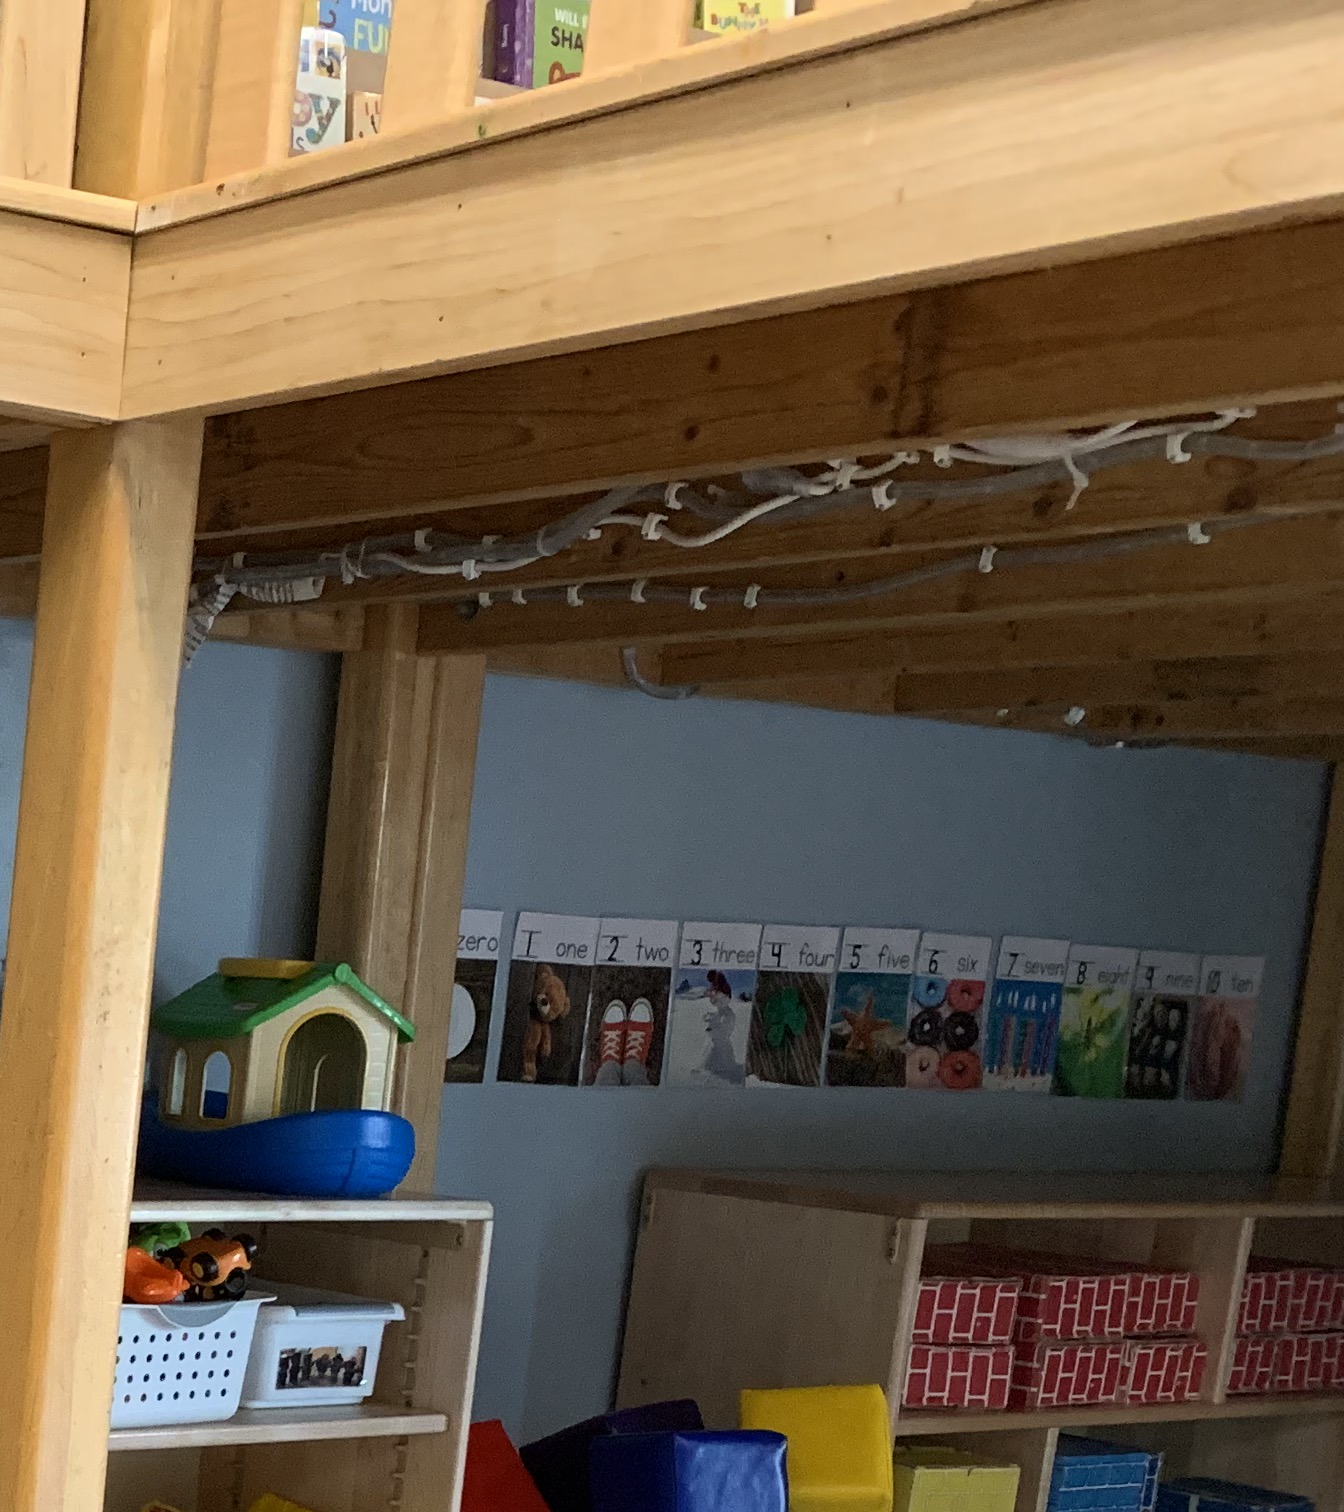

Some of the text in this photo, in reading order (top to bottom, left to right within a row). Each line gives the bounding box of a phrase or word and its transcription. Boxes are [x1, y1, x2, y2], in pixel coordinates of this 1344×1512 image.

[554, 7, 580, 28] WILL
[457, 934, 499, 953] zero
[555, 941, 589, 959] one
[606, 935, 670, 962] 2 two
[690, 939, 756, 966] 3 three
[770, 942, 835, 968] 4 four
[849, 943, 911, 970] 5 five
[928, 949, 979, 975] 6 six
[1007, 952, 1064, 977] 7 seven
[1076, 960, 1088, 985] 8
